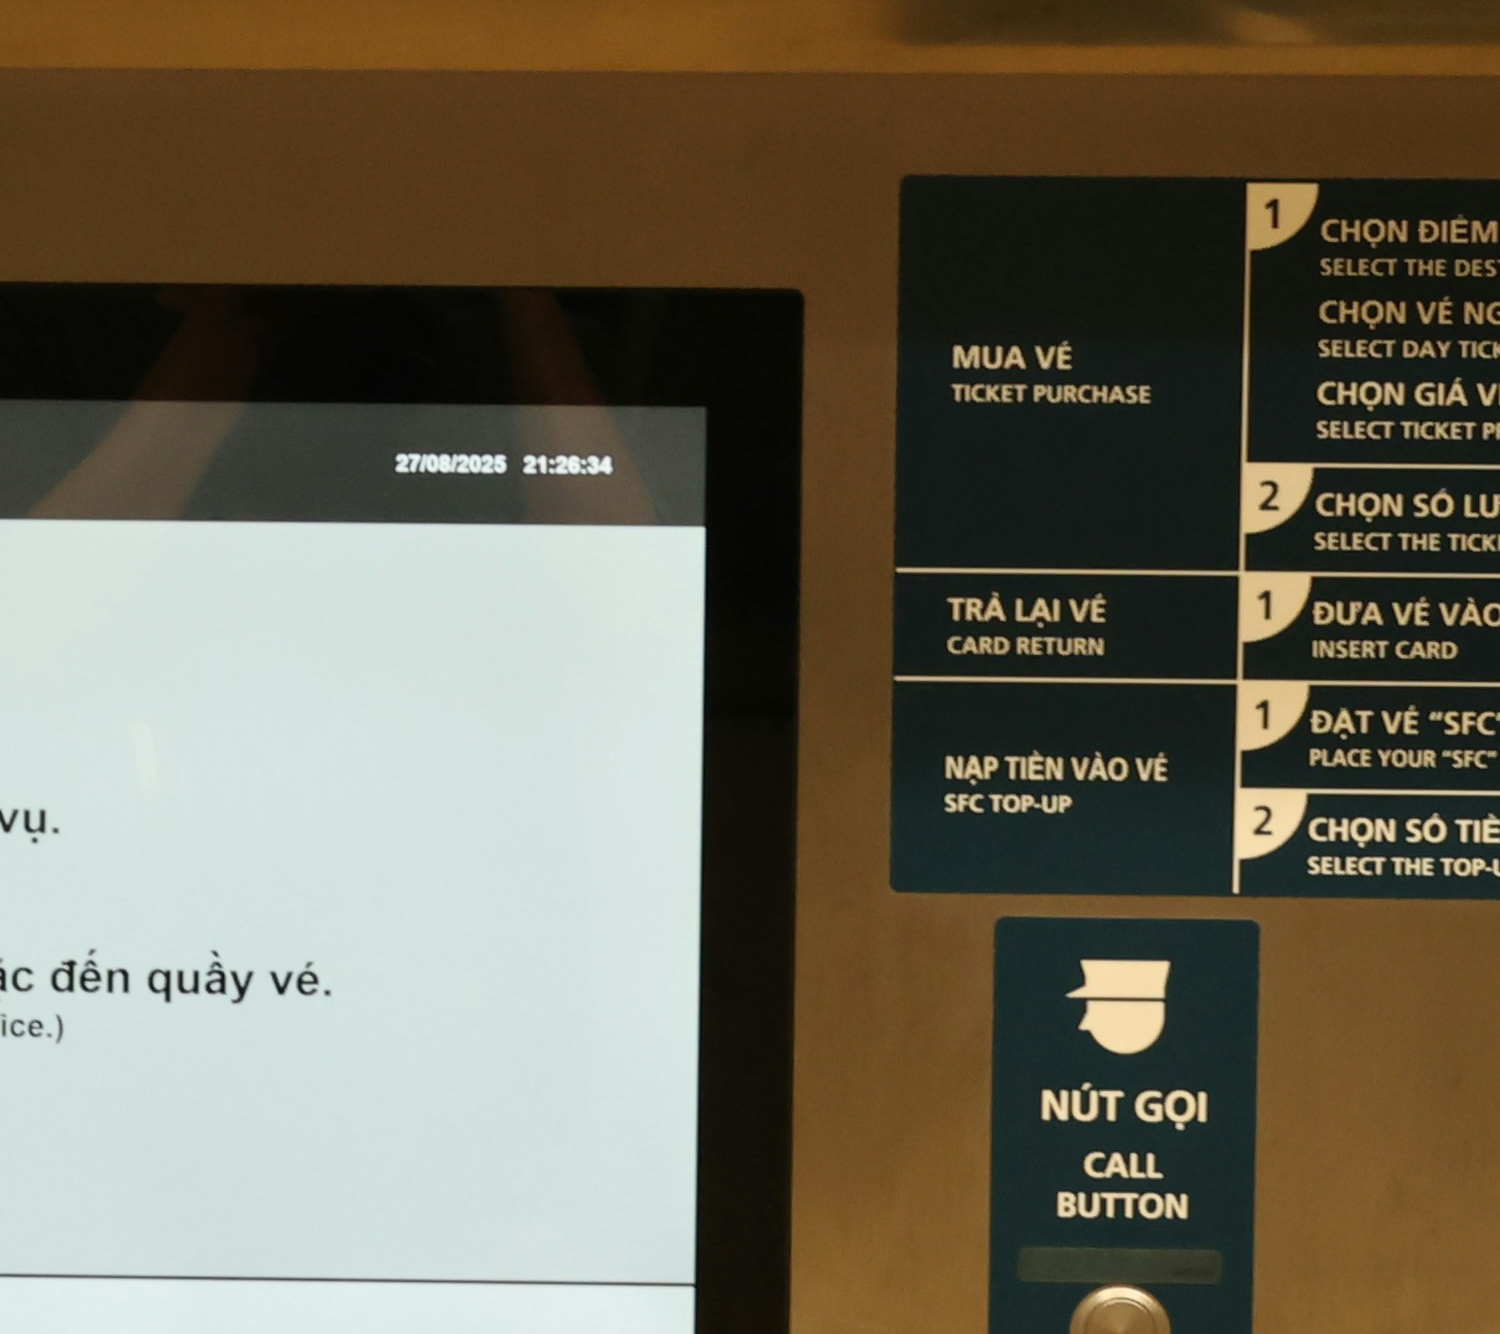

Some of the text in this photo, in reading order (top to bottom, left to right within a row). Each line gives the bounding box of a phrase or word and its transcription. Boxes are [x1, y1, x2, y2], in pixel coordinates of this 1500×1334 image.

[1319, 300, 1406, 330] CHỌN
[1416, 296, 1453, 325] VÉ
[1318, 339, 1396, 358] SELECT
[1402, 340, 1451, 358] DAY
[1317, 381, 1405, 412] CHỌN
[1414, 377, 1468, 406] GIÁ
[395, 453, 613, 475] 27/08/2025 21:26:34
[1309, 748, 1372, 767] PLACE
[1377, 749, 1436, 768] YOUR
[1442, 750, 1498, 769] "SFC"
[50, 949, 129, 994] đến
[147, 950, 254, 1004] quầy
[270, 962, 331, 996] vé.
[1041, 1082, 1207, 1130] NÚT GỌI
[1084, 1152, 1163, 1179] CALL
[1057, 1192, 1188, 1219] BUTTON
